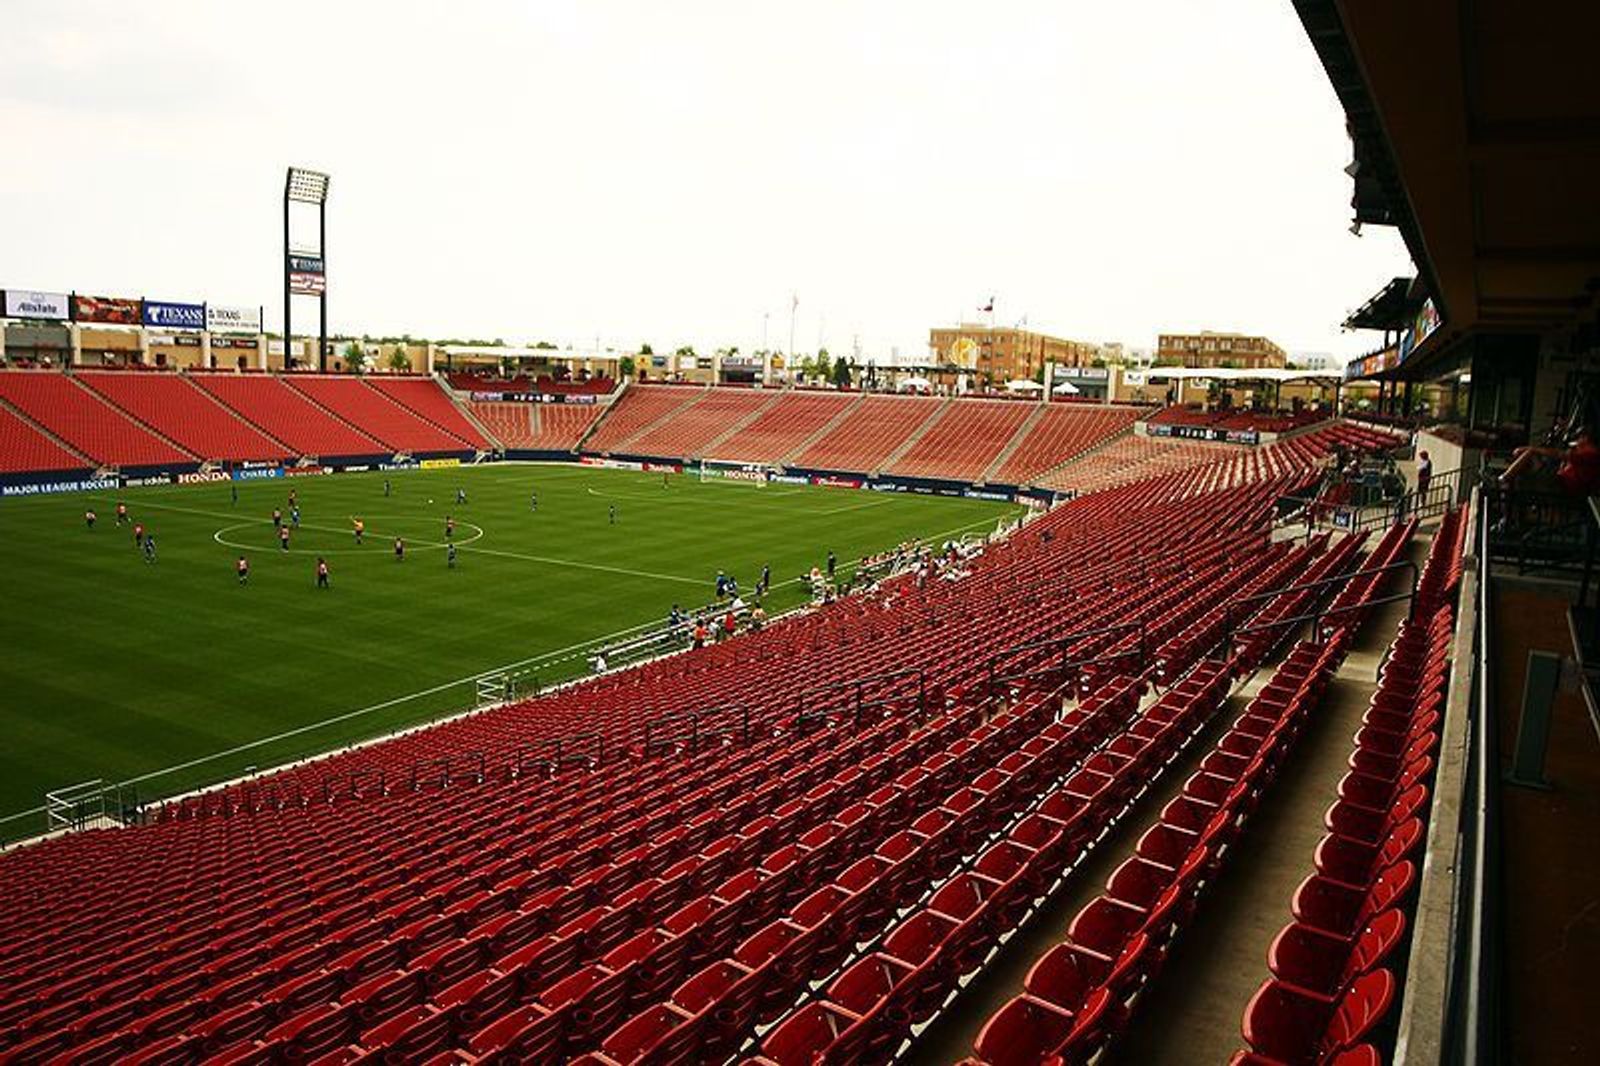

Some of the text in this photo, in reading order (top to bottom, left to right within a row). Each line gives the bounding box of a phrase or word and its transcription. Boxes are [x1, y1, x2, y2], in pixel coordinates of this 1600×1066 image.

[17, 302, 57, 313] Allstate
[162, 306, 203, 320] TEXANS
[178, 472, 231, 483] HONDA
[3, 484, 39, 495] MAJOR
[41, 482, 78, 493] LEAGUE
[80, 479, 115, 490] SOCCER
